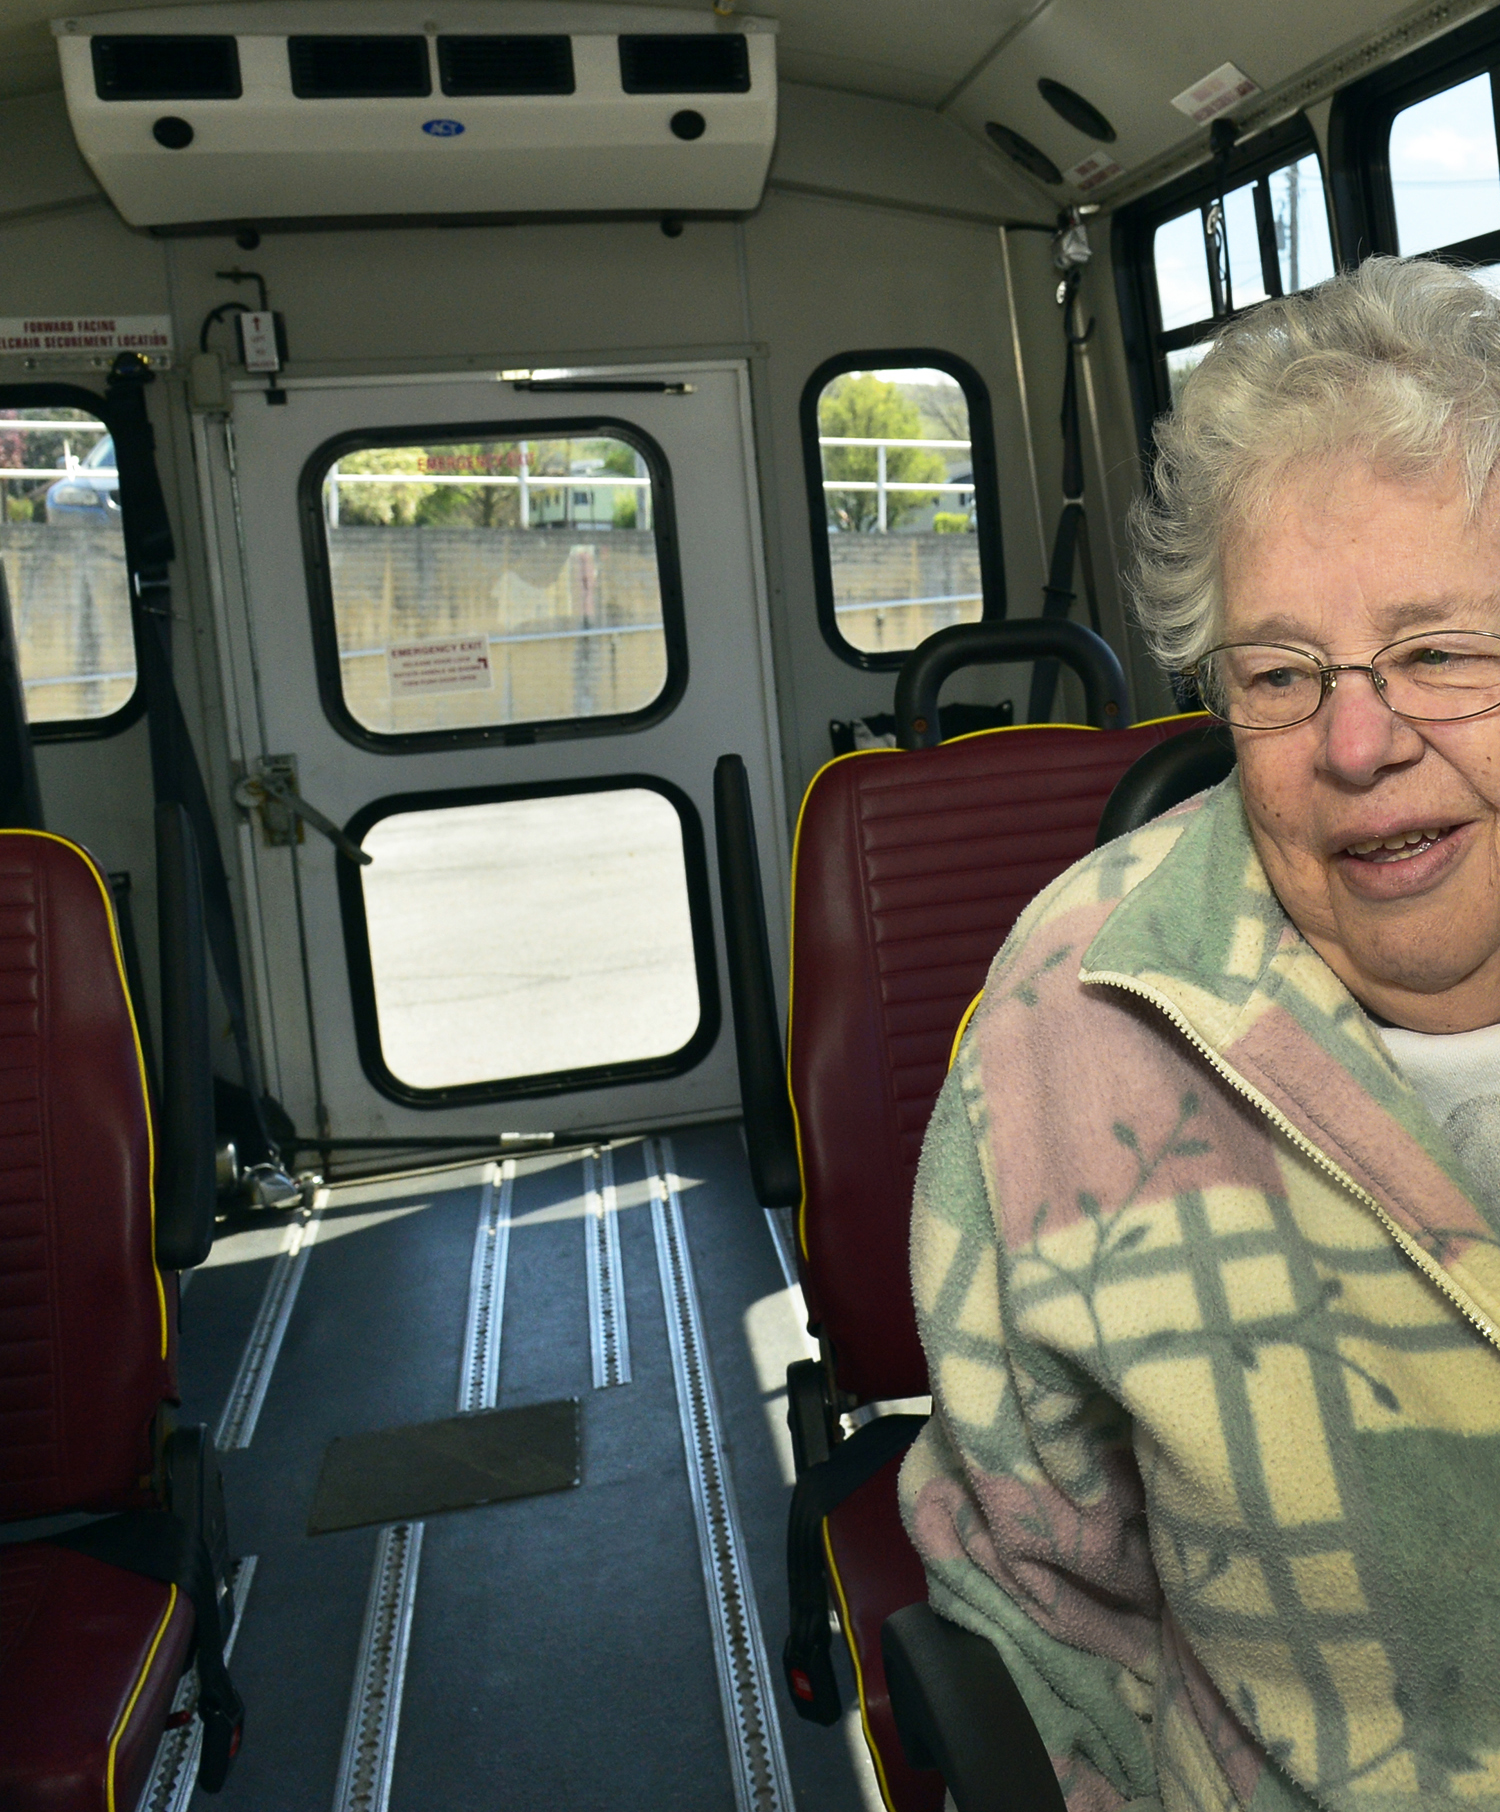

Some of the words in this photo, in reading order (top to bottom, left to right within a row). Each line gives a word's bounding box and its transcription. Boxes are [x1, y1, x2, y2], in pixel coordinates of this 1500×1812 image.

[24, 320, 74, 333] FORWARD
[77, 320, 116, 332] FACING
[44, 335, 113, 348] SECUREMENT
[117, 334, 168, 346] LOCATION
[391, 644, 457, 658] EMERGENCY
[460, 641, 482, 651] EXIT
